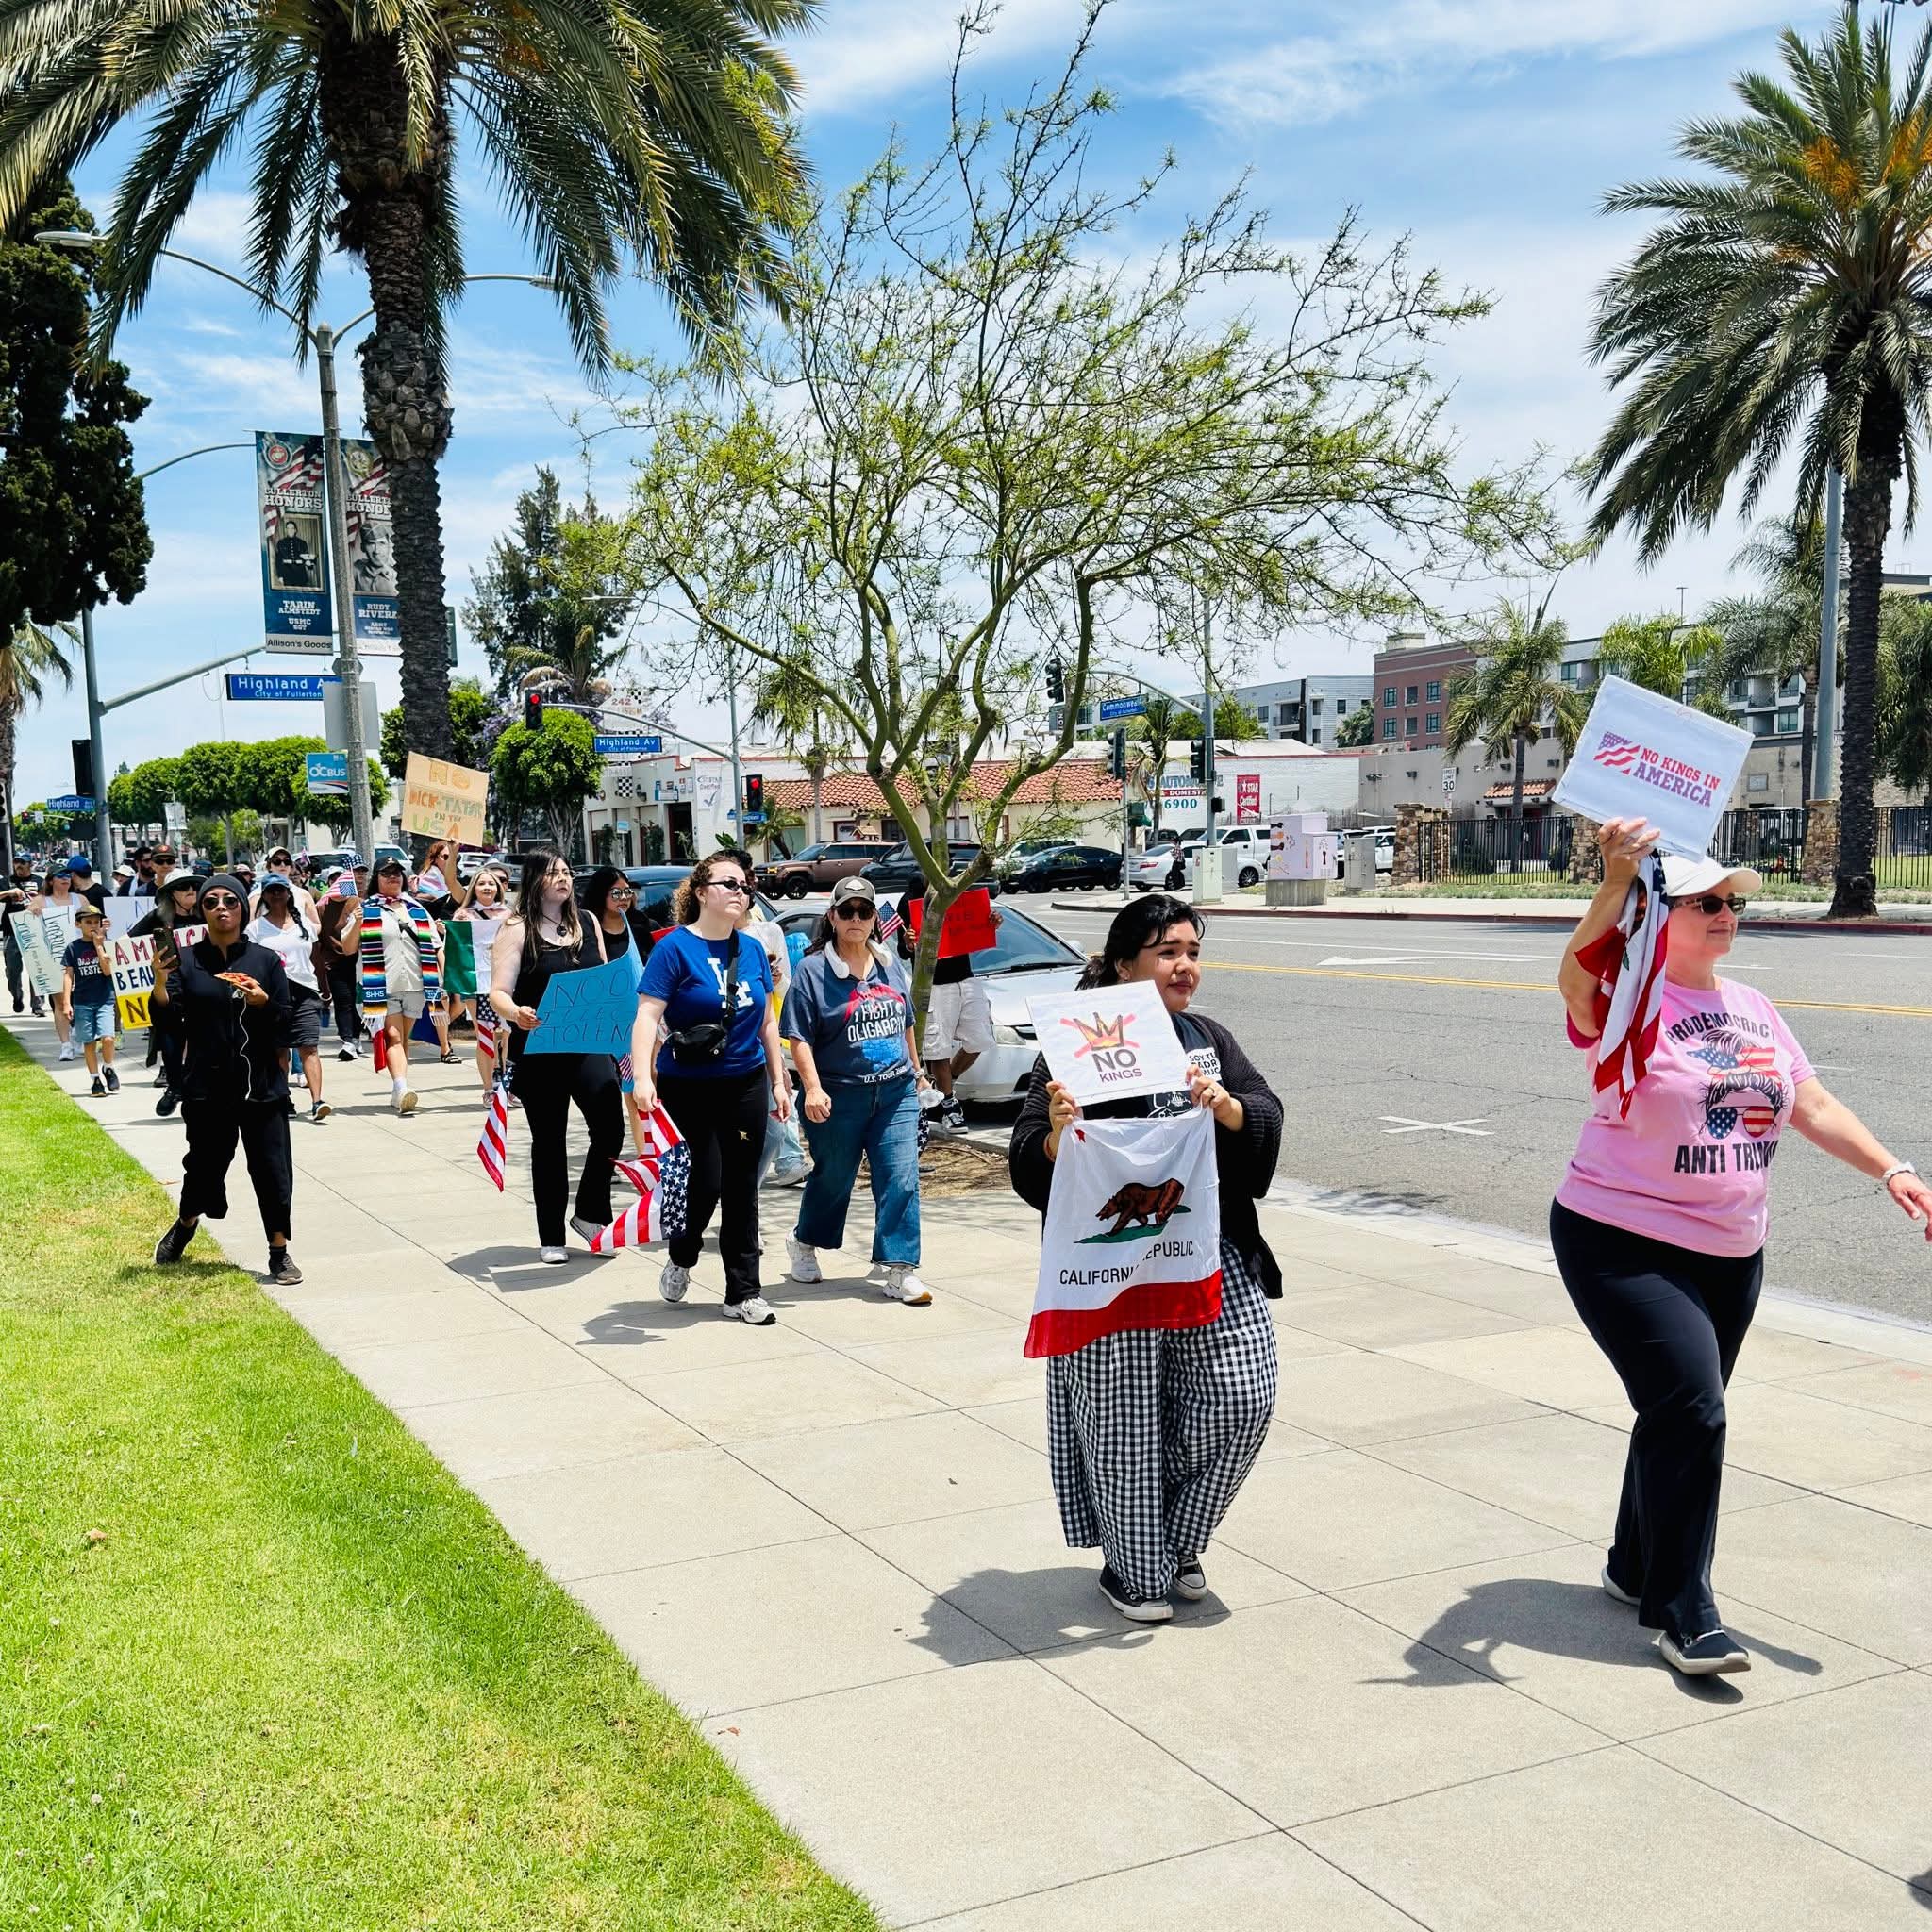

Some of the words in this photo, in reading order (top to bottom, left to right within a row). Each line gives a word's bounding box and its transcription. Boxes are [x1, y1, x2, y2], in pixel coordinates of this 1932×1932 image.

[264, 487, 322, 498] FULLERTON
[264, 495, 323, 509] HONORS
[346, 494, 392, 505] FULLERT
[282, 600, 316, 609] TARIN
[366, 603, 391, 611] RUDY
[278, 607, 322, 616] ALMSTEDT
[288, 617, 312, 625] USMC
[267, 639, 303, 648] Allison's
[238, 677, 308, 691] Highland
[1102, 699, 1140, 711] Commonwea
[599, 738, 640, 748] Highland
[643, 738, 656, 746] Av
[428, 761, 471, 790] NO
[1640, 747, 1660, 764] NO
[1660, 756, 1702, 781] KINGS
[1703, 774, 1721, 791] IN
[1246, 782, 1259, 793] STAR
[1443, 780, 1455, 791] 30
[1632, 761, 1713, 808] AMERICA
[48, 799, 80, 809] Highland
[1164, 798, 1198, 808] 6900
[412, 814, 460, 839] USA
[77, 964, 103, 977] TESTE
[365, 991, 385, 999] SHHS
[860, 999, 895, 1022] FIGHT
[847, 1015, 906, 1043] OLIGARCHY
[1665, 1011, 1775, 1045] PRODEMOCRAC
[532, 1023, 632, 1048] STOLEN
[1091, 1048, 1137, 1073] NO
[1191, 1058, 1217, 1068] ADR
[864, 1074, 877, 1083] U.S.
[878, 1070, 895, 1081] TOUR
[1099, 1068, 1143, 1084] KINGS
[1674, 1144, 1726, 1174] ANTI
[1142, 1240, 1194, 1262] EPUBLIC
[1059, 1263, 1140, 1286] CALIFORNI
